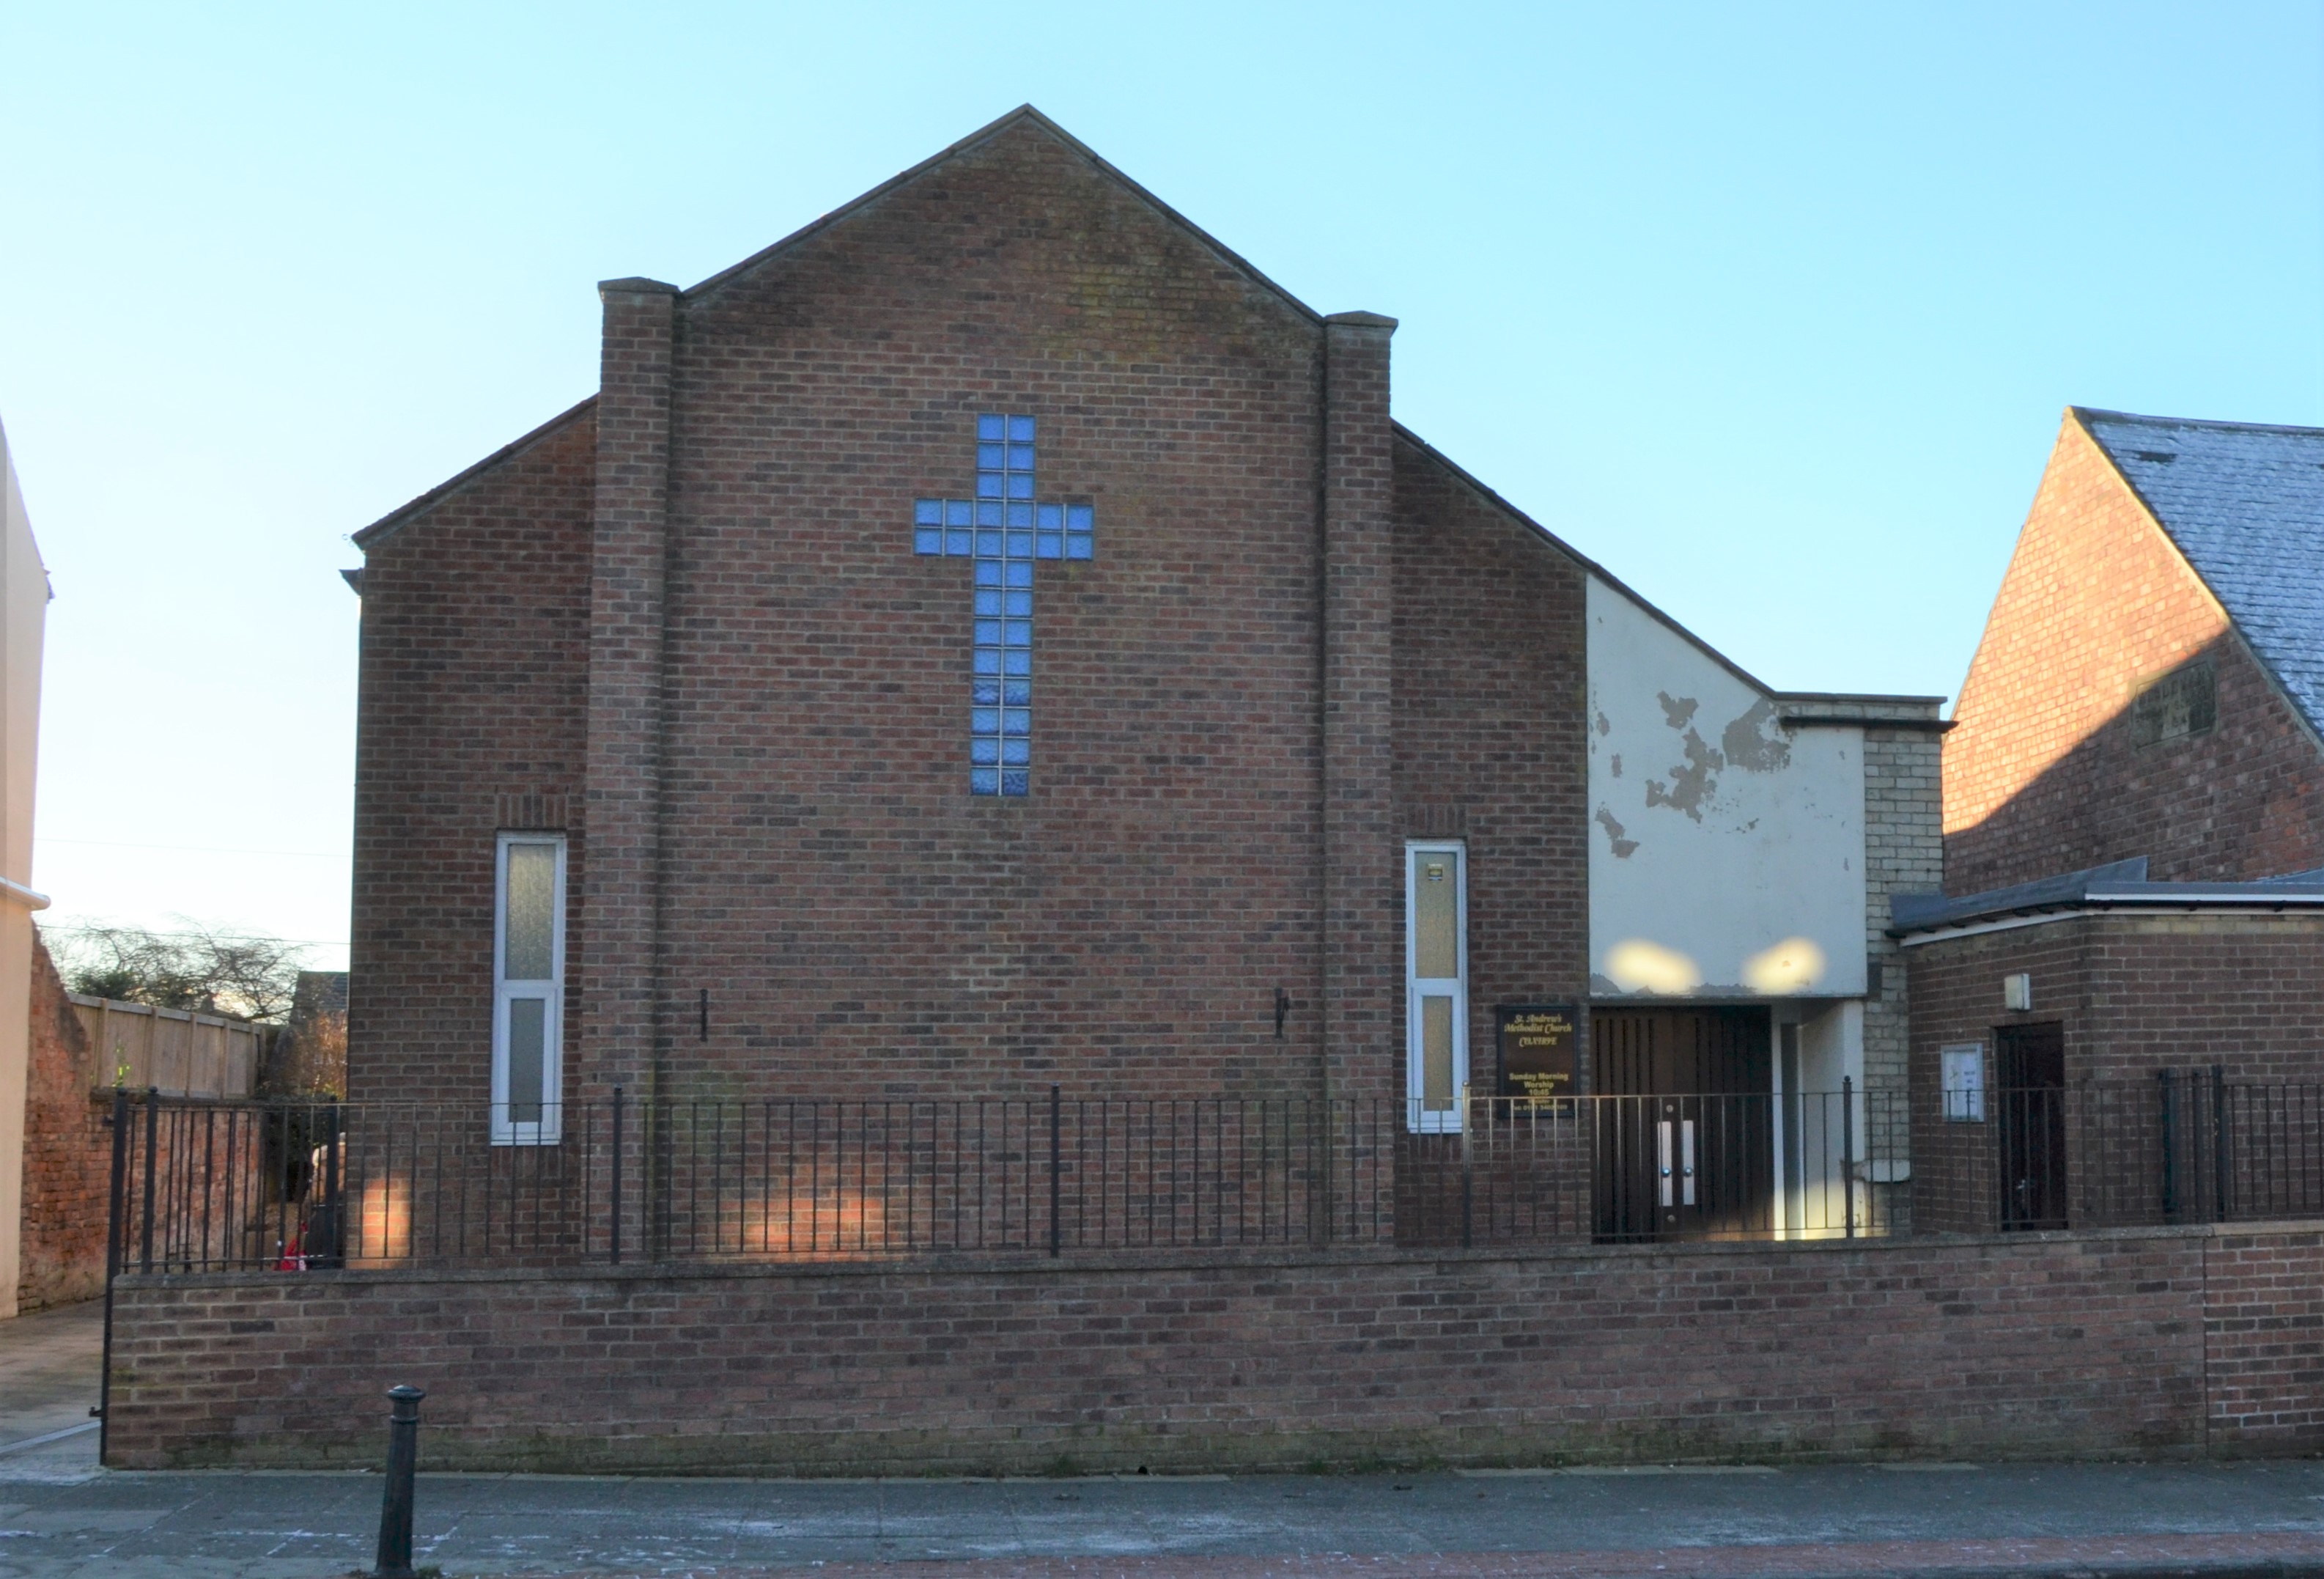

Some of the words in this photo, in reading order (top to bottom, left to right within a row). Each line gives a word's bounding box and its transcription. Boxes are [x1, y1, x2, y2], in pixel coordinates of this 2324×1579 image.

[1526, 1014, 1562, 1023] Andrew's
[1505, 1023, 1542, 1032] Methodist
[1544, 1023, 1572, 1034] Church
[1509, 1073, 1537, 1081] Sunday
[1538, 1073, 1568, 1081] Morning
[1524, 1081, 1554, 1089] Worship
